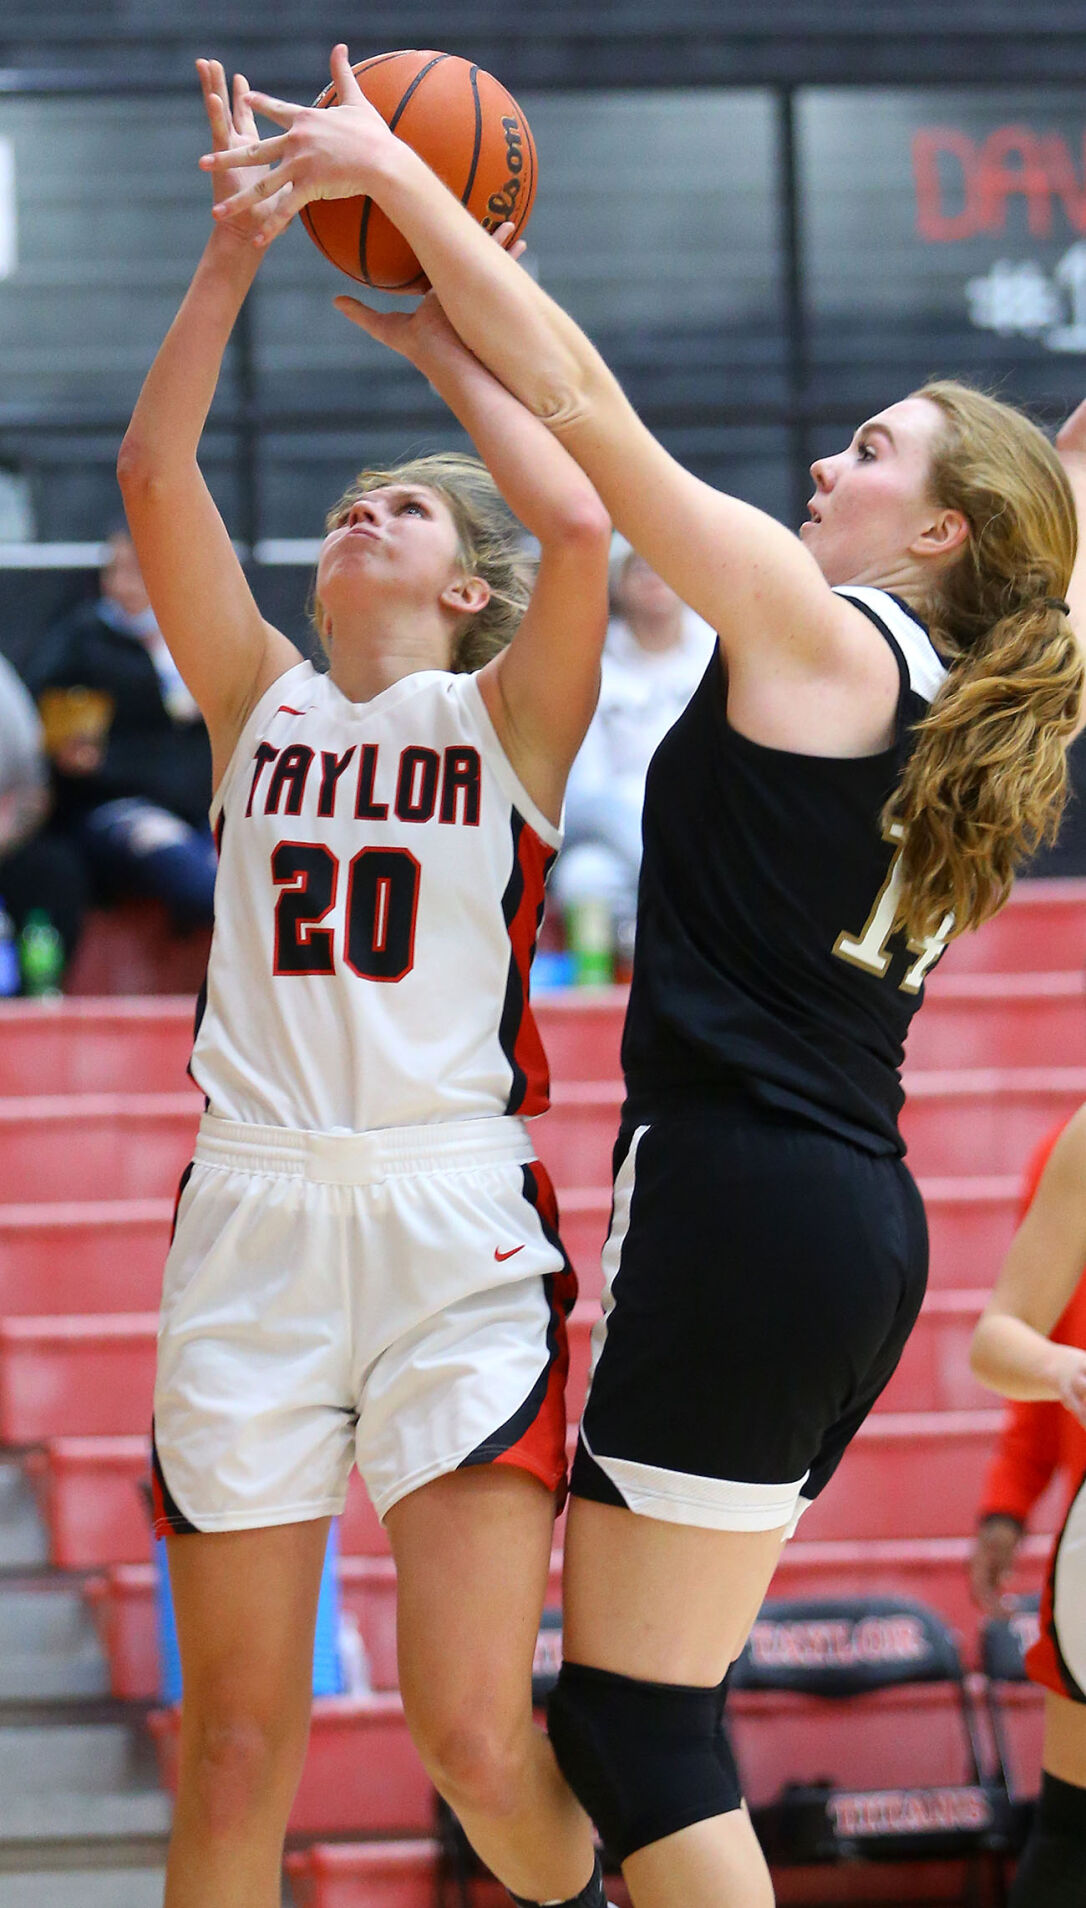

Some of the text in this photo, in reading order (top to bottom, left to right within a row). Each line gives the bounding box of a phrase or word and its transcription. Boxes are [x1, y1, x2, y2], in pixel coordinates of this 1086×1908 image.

[481, 115, 523, 236] ilson
[245, 741, 482, 827] TAYLOR
[270, 840, 422, 983] 20
[750, 1617, 931, 1669] TAYLOR
[828, 1786, 992, 1838] TITANS
